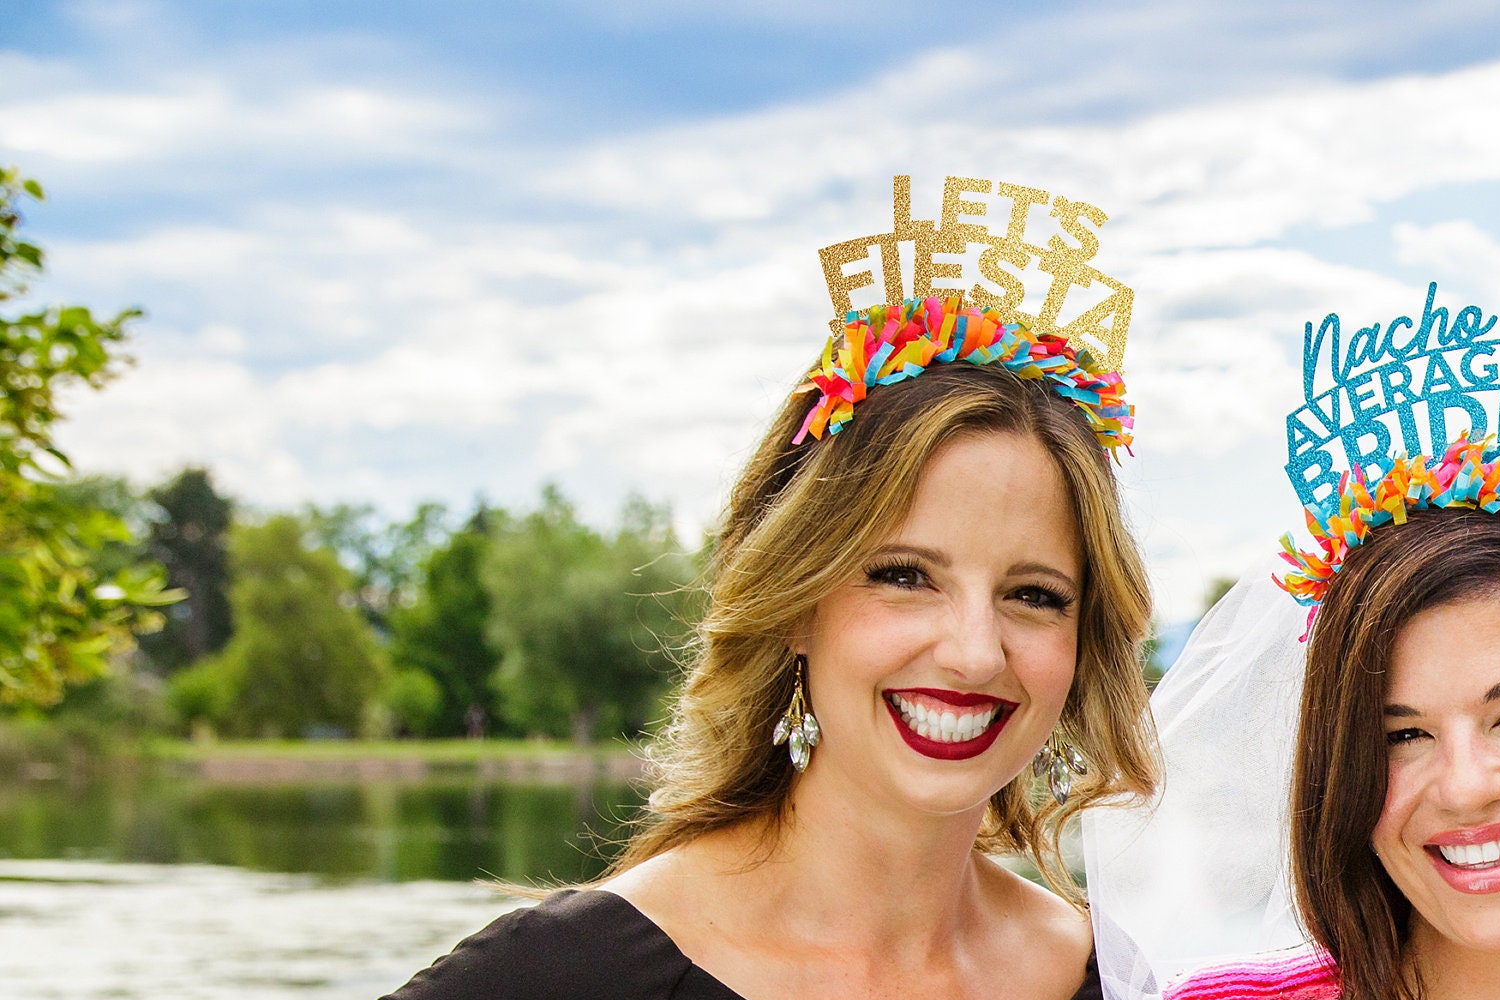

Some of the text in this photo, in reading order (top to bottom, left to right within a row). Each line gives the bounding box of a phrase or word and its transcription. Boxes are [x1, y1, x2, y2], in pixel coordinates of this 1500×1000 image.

[893, 175, 1110, 266] LET'S
[818, 232, 1135, 375] FIESTA
[1303, 281, 1499, 402] Nacho
